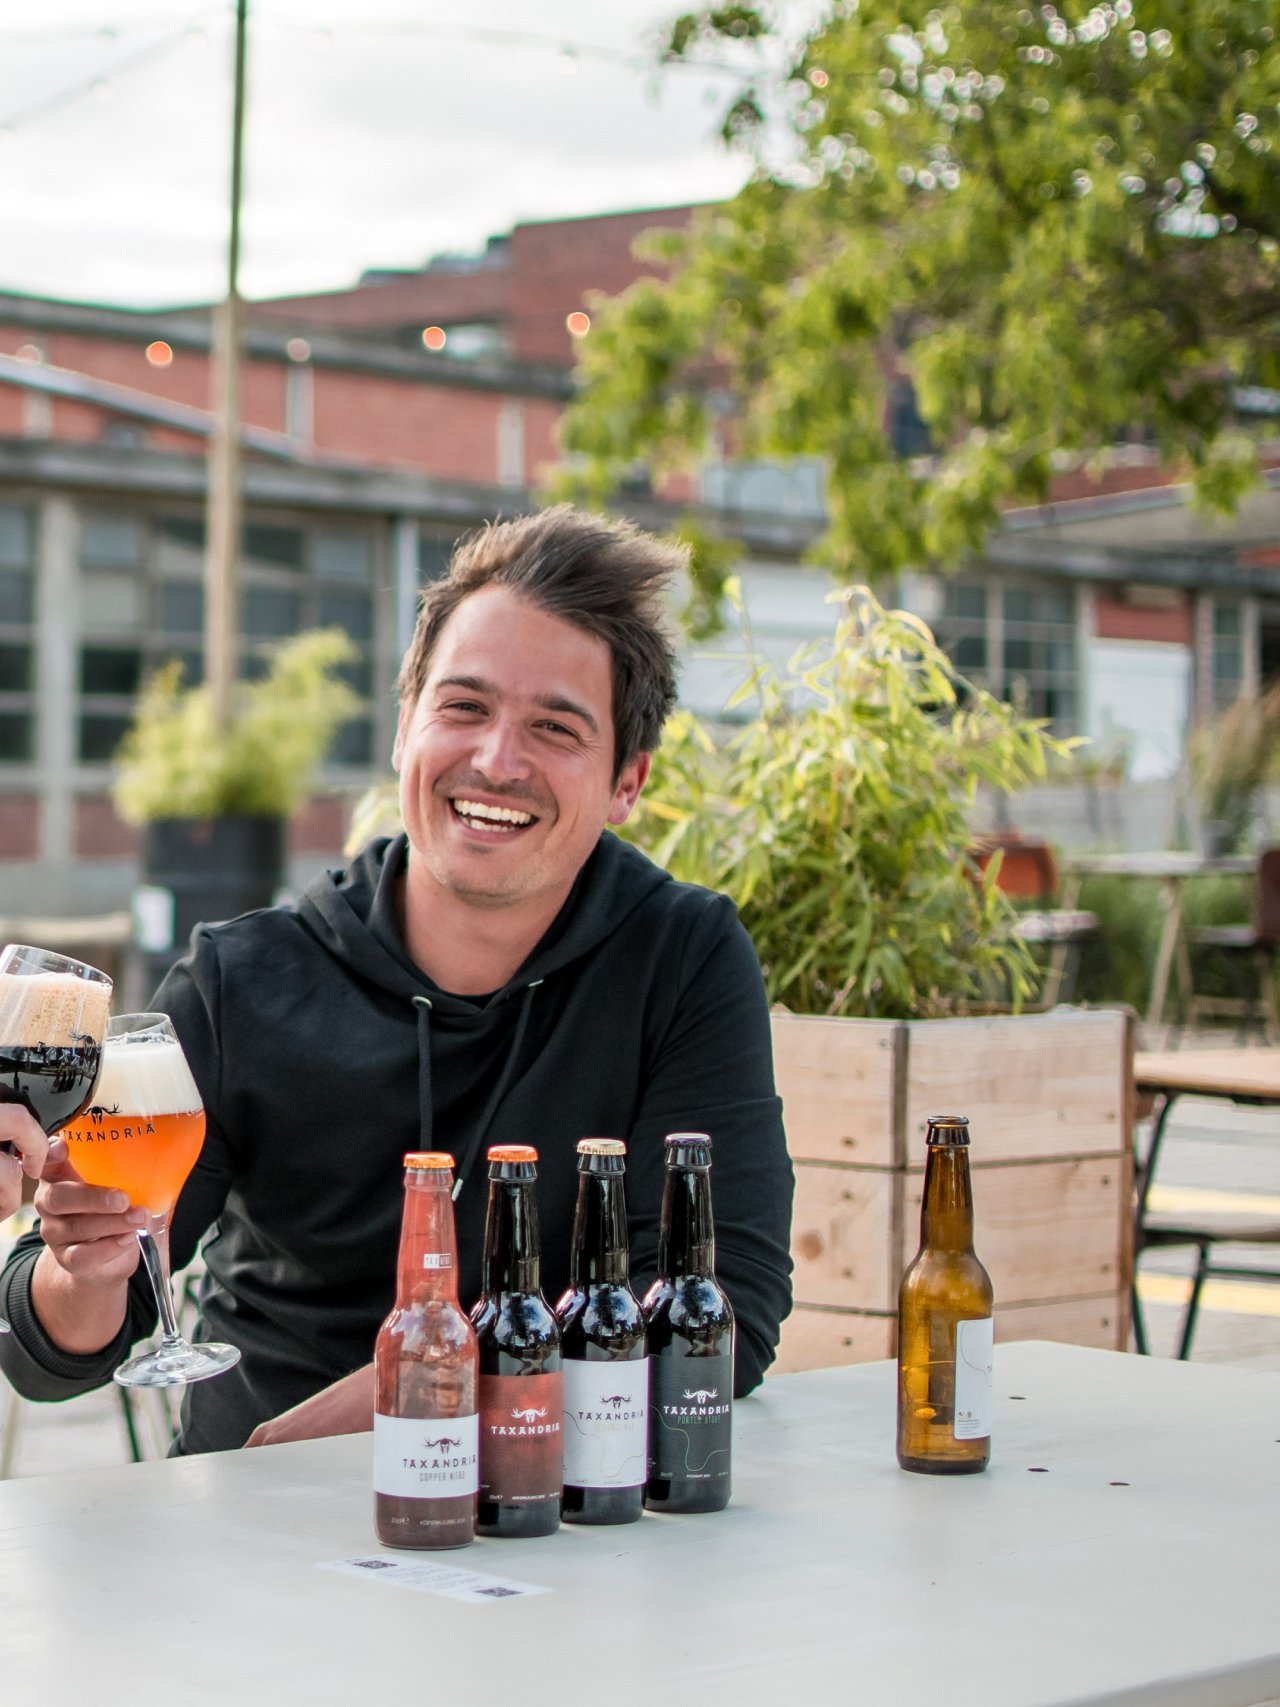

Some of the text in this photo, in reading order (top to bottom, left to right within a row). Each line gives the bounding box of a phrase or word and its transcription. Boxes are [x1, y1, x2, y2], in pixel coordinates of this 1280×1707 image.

[663, 1404, 730, 1415] TAXANDRIA
[578, 1410, 644, 1421] TAXANDRIA
[491, 1422, 560, 1435] TAXANDRIA
[402, 1454, 477, 1469] TAXANDRIA
[419, 1472, 446, 1482] COPPER
